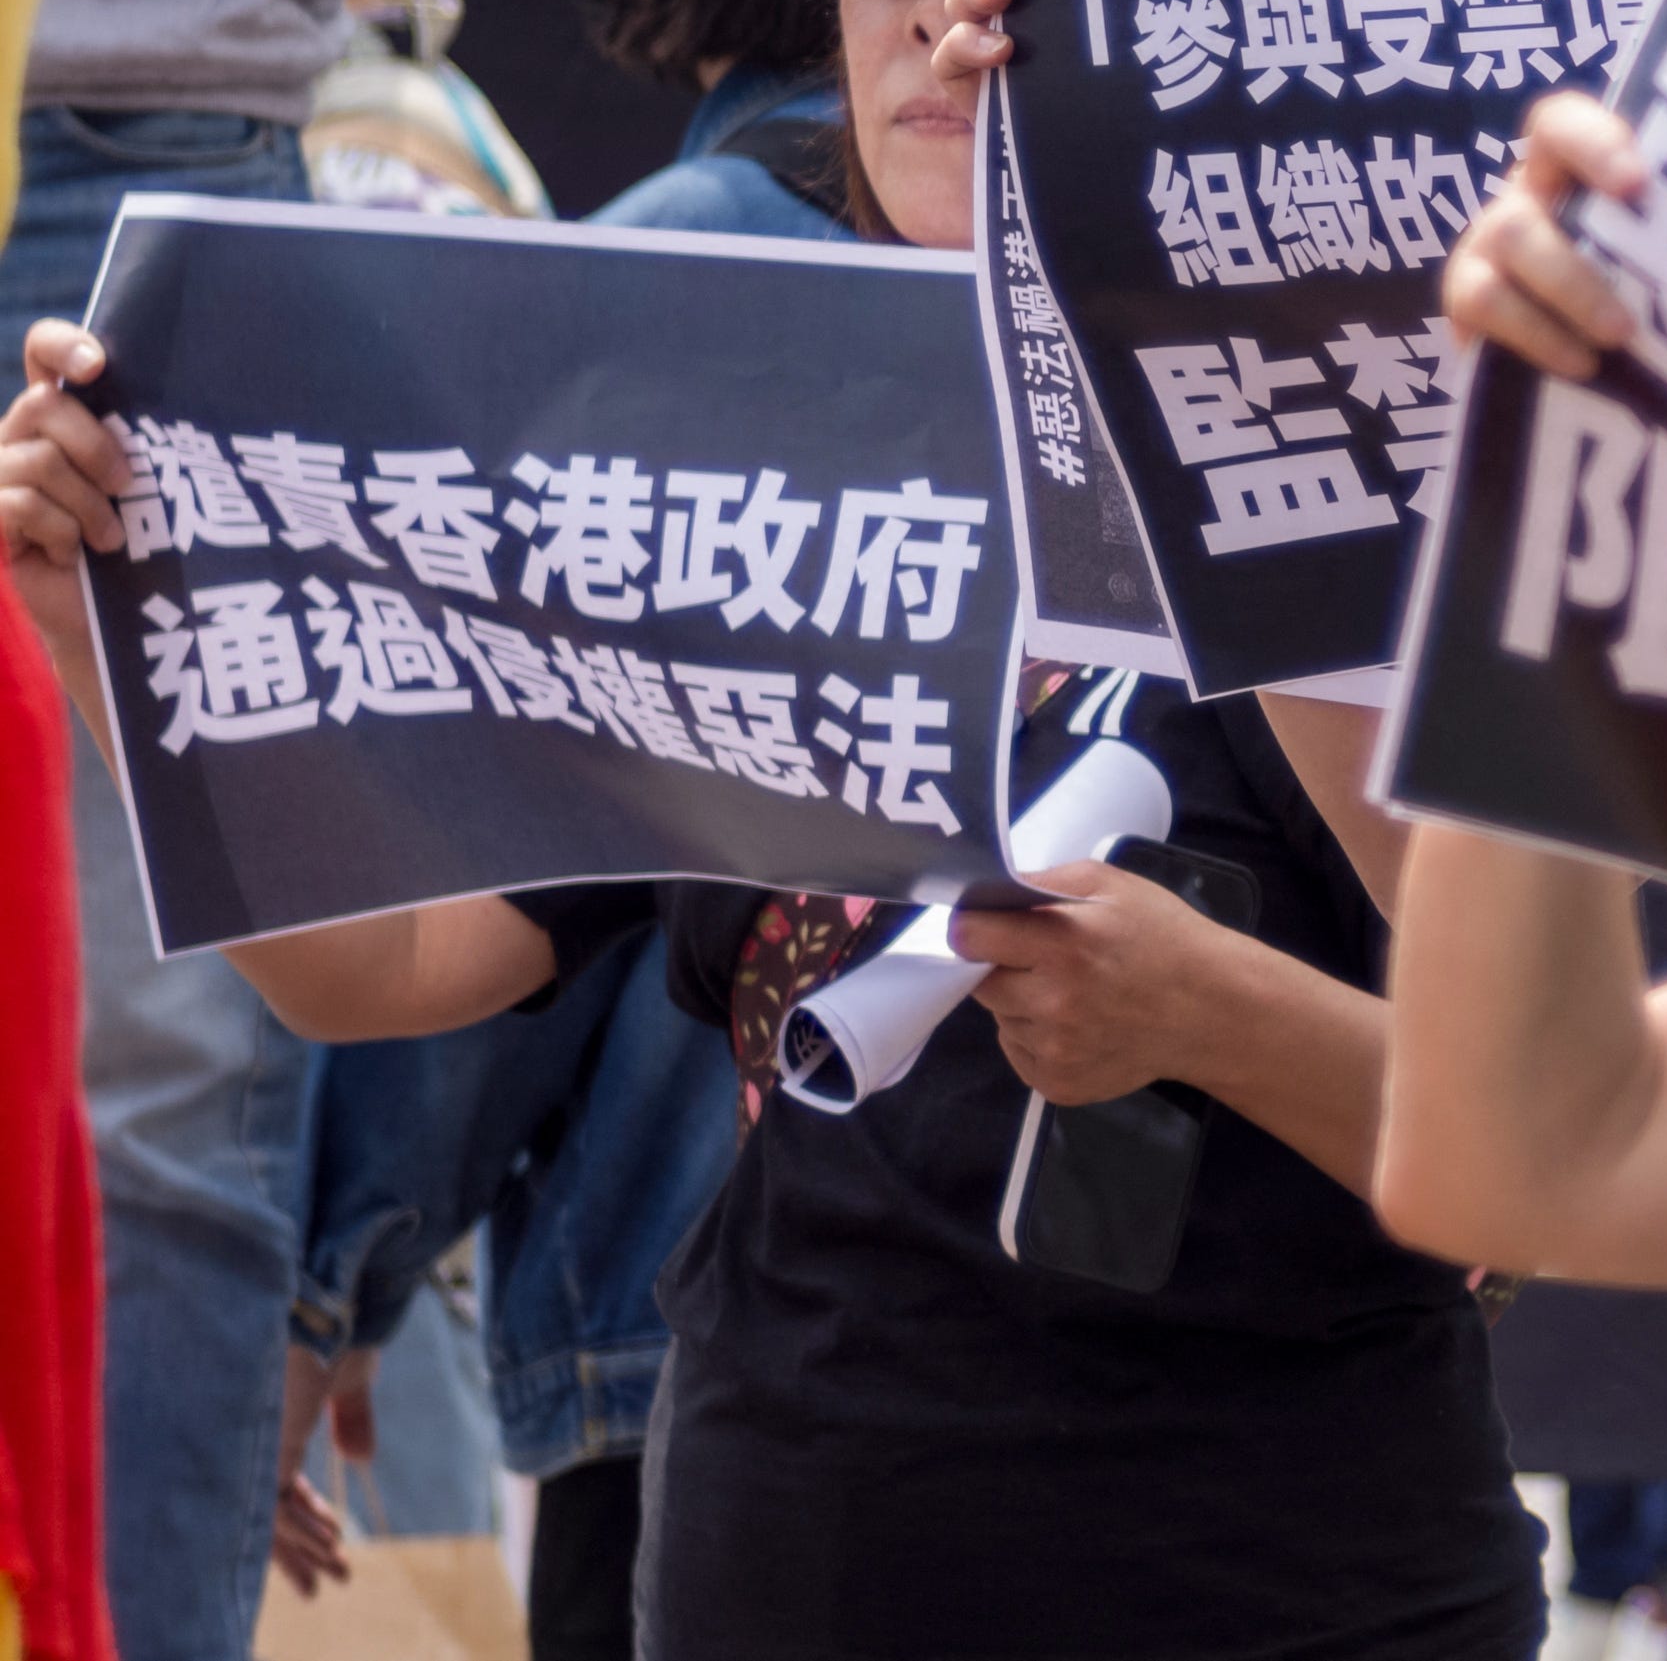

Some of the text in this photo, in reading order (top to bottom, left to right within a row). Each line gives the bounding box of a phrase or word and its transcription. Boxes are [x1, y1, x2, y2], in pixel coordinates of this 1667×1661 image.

[1148, 130, 1530, 289] 組織的
[102, 412, 988, 643] 譴責香港政府
[141, 574, 961, 836] 通過侵權惡法
